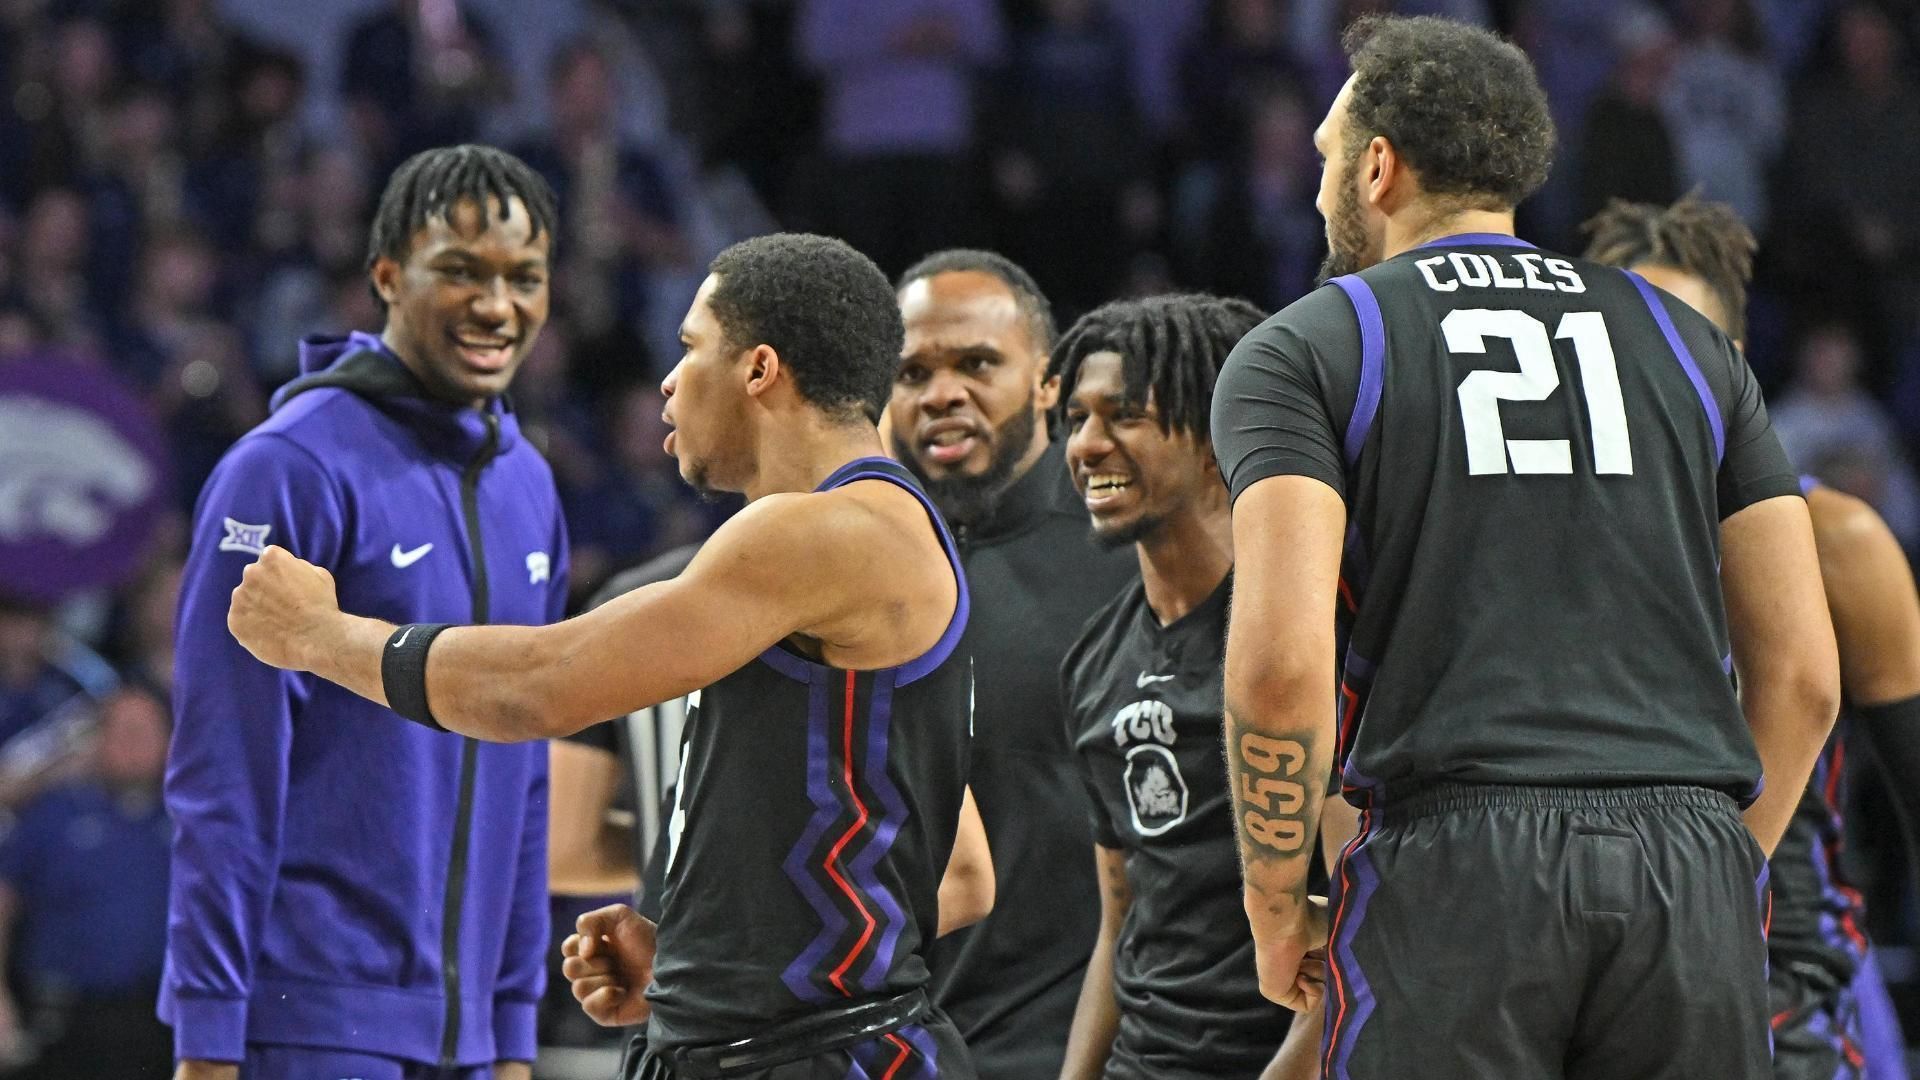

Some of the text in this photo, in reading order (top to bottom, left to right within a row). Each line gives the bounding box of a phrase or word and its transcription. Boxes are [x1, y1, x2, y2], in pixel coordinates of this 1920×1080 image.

[1414, 252, 1586, 293] COLES
[1440, 308, 1633, 476] 21
[1241, 732, 1306, 851] 859
